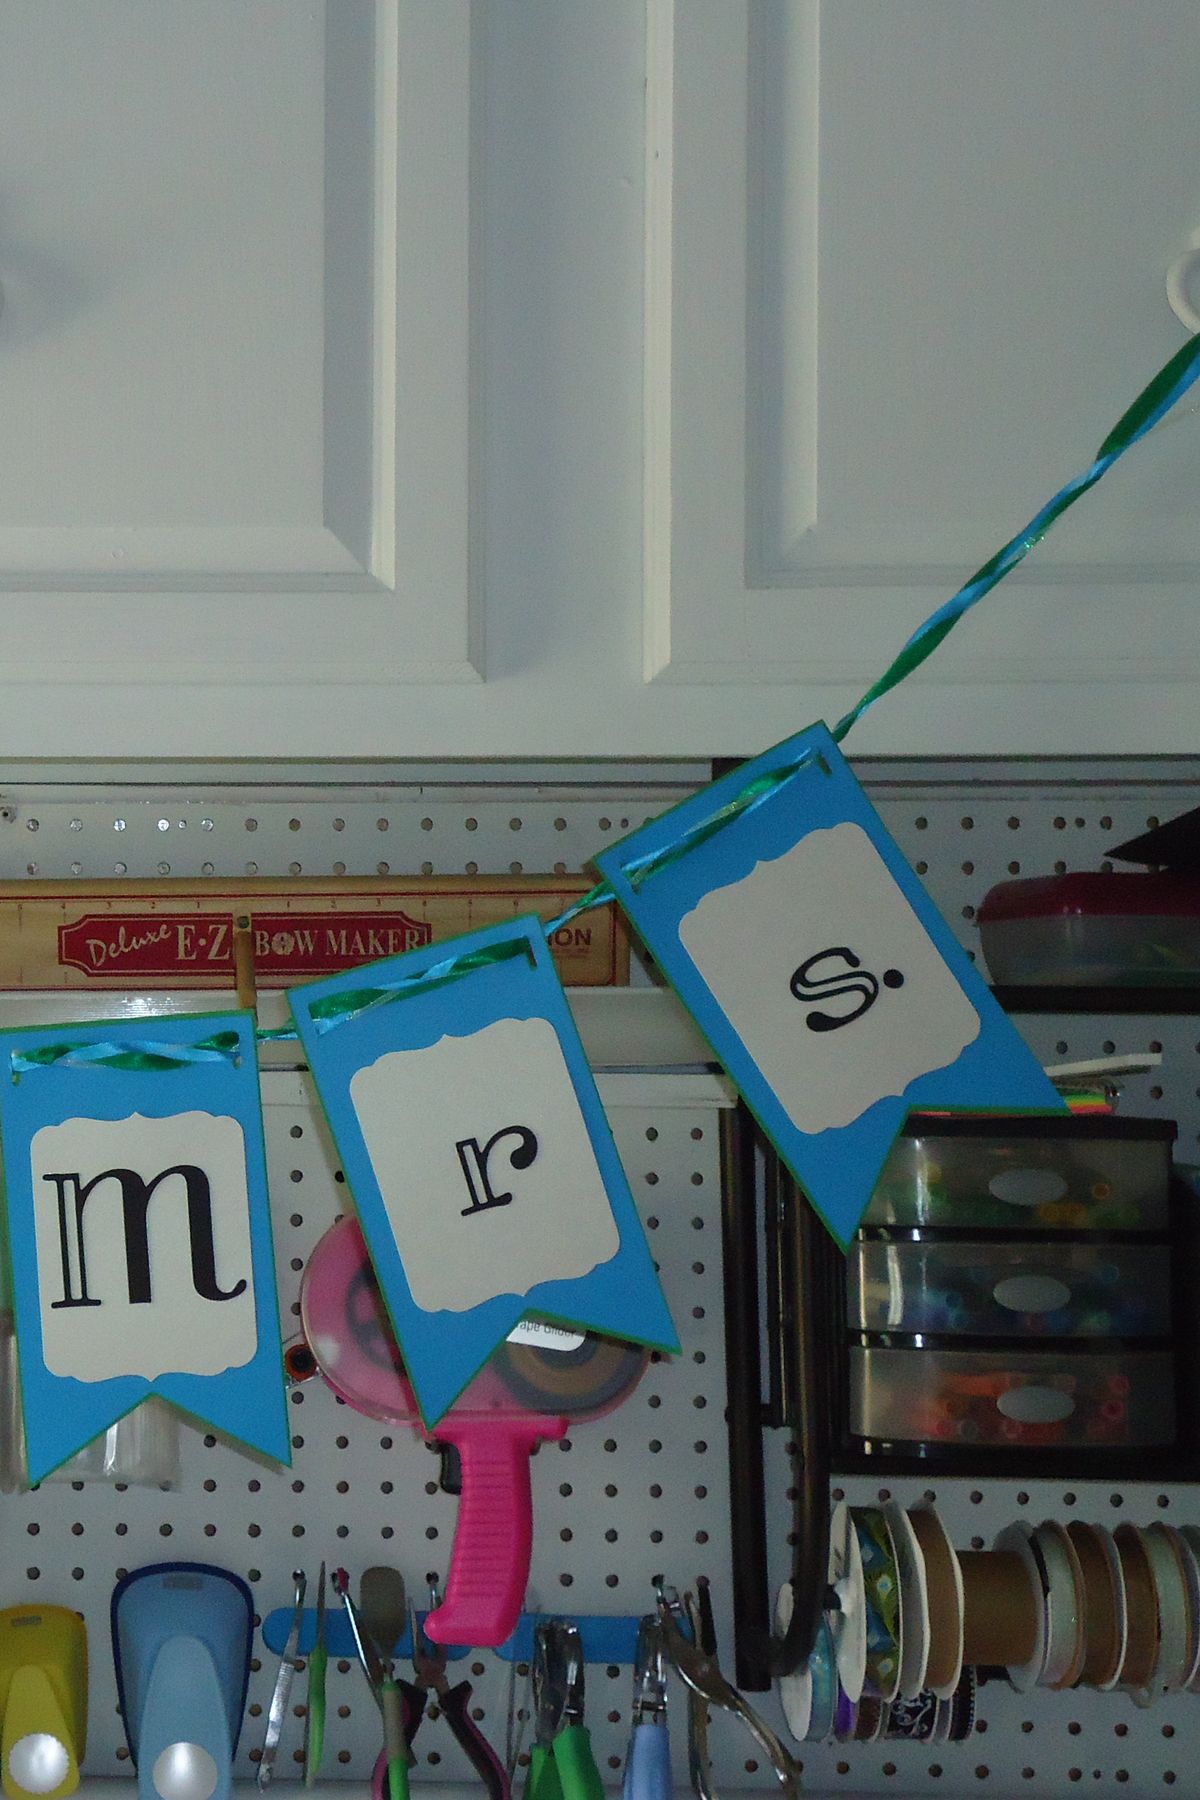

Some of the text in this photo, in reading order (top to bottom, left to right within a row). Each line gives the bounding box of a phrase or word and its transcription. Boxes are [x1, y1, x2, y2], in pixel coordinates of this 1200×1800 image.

[86, 924, 171, 966] Deluxe
[255, 929, 317, 956] BOW
[326, 928, 420, 956] MAKER
